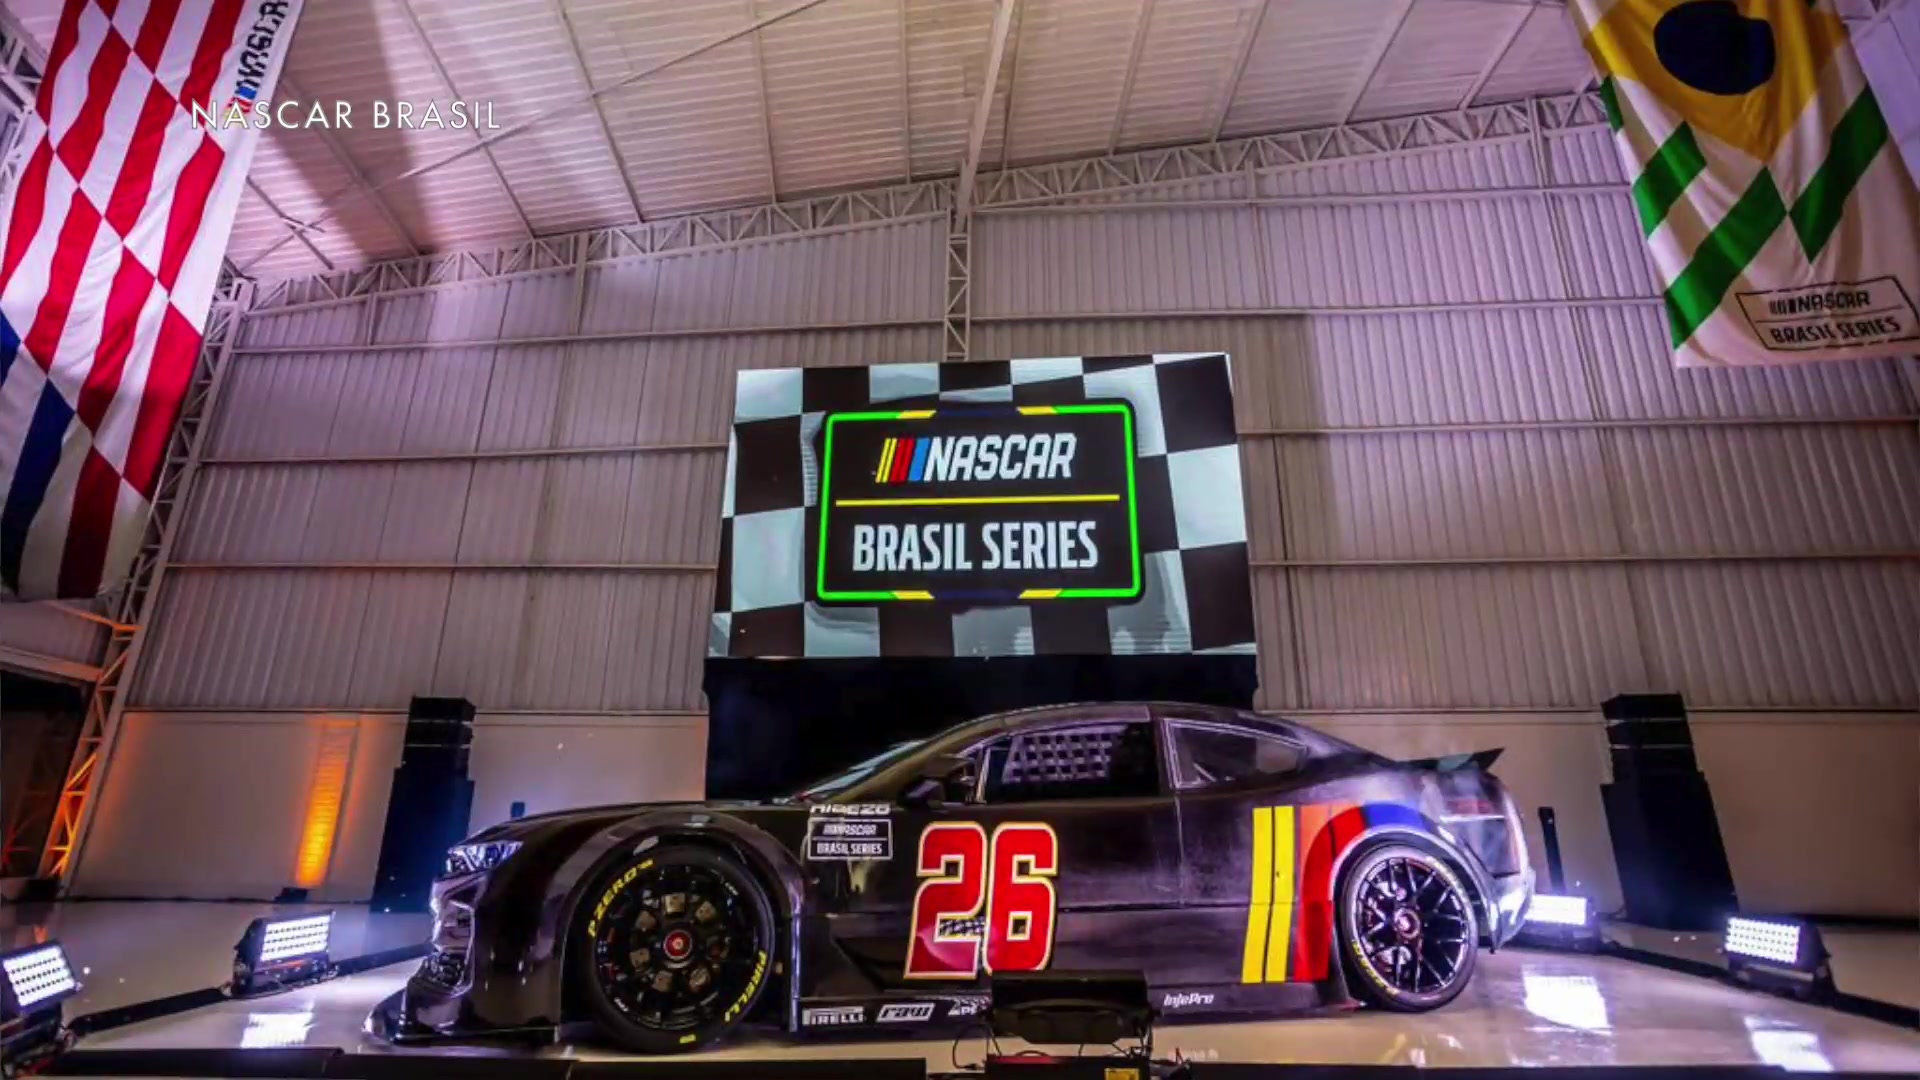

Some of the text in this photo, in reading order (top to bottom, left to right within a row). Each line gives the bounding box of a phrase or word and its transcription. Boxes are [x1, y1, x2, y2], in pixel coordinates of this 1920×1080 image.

[1800, 292, 1871, 313] NASCAR
[1770, 316, 1901, 344] BRASIL SERIES
[923, 432, 1078, 483] NASCAR
[852, 520, 1099, 572] BRASIL SERIES
[816, 842, 883, 855] BRASIL SERIES
[903, 820, 1059, 980] 26
[802, 1006, 865, 1025] PIRELLI
